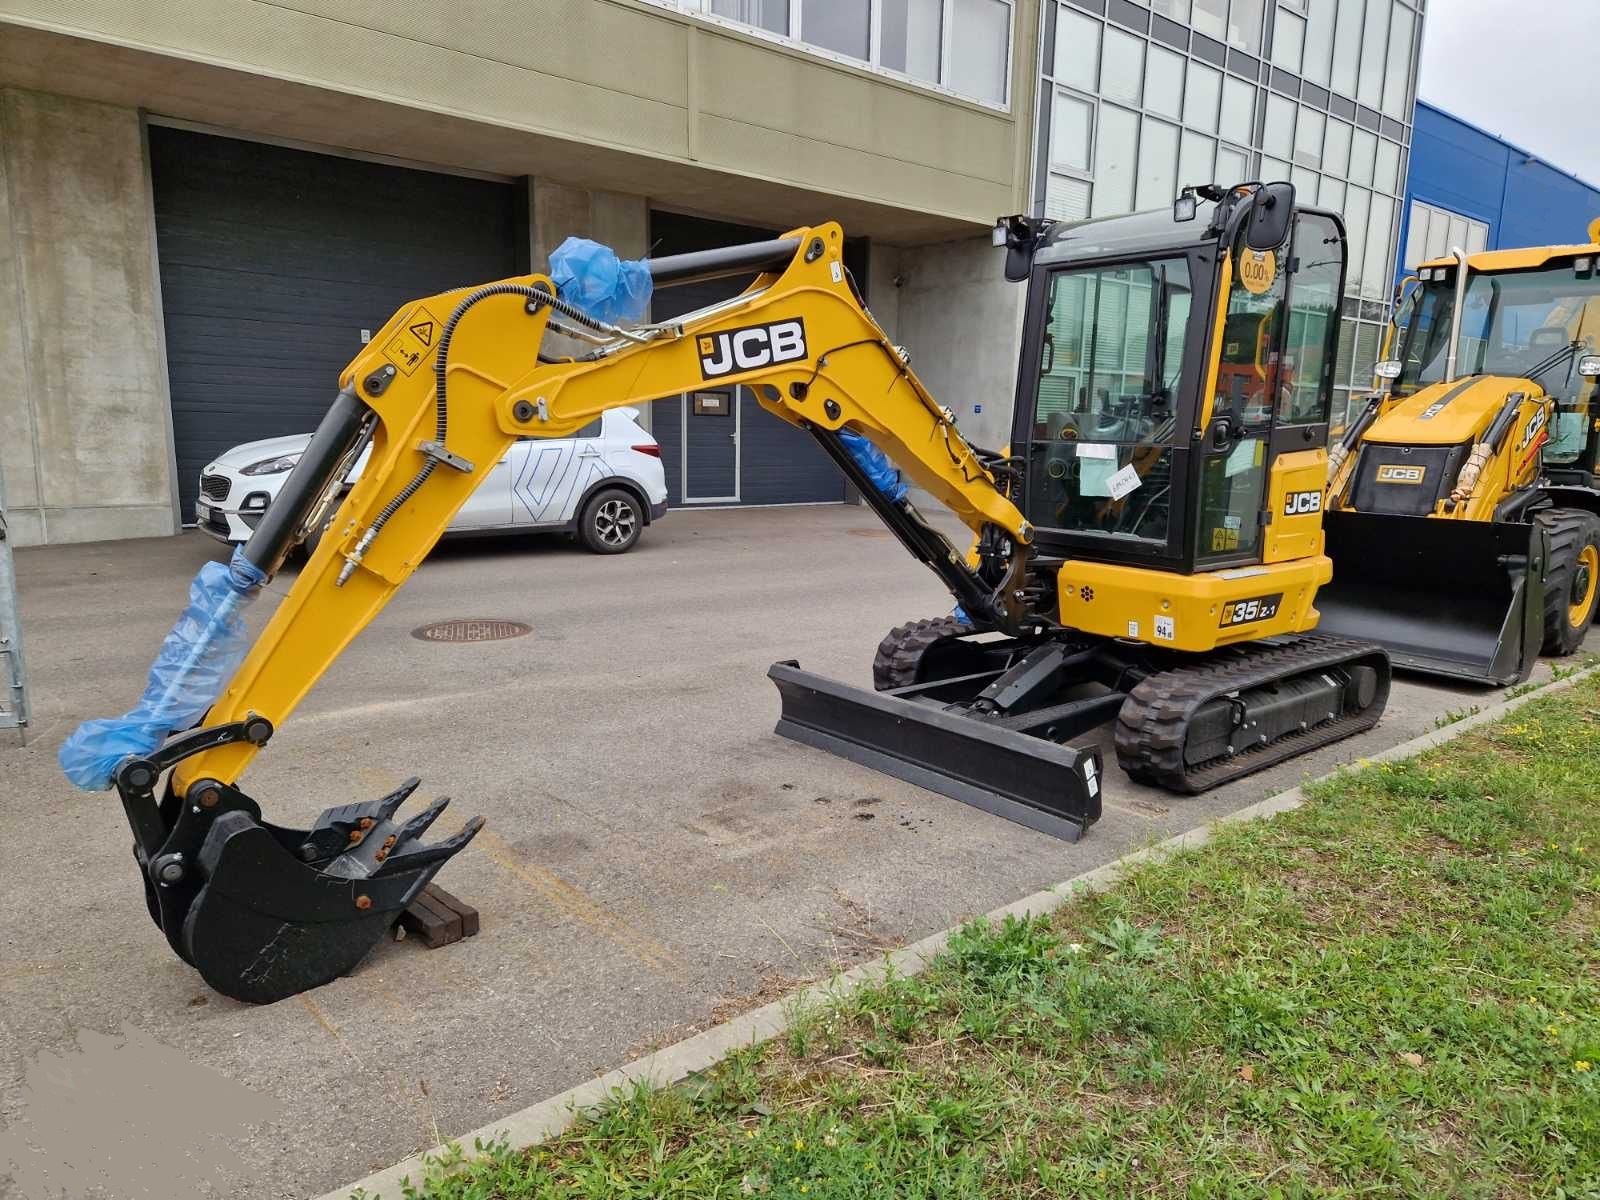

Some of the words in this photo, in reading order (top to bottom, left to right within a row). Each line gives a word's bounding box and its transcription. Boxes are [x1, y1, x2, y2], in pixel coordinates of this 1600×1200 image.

[702, 322, 805, 375] JCB
[1523, 406, 1544, 448] JCB
[1382, 469, 1420, 480] JCB
[1285, 492, 1320, 514] JCB
[1232, 600, 1259, 622] 35
[1157, 625, 1167, 637] 94
